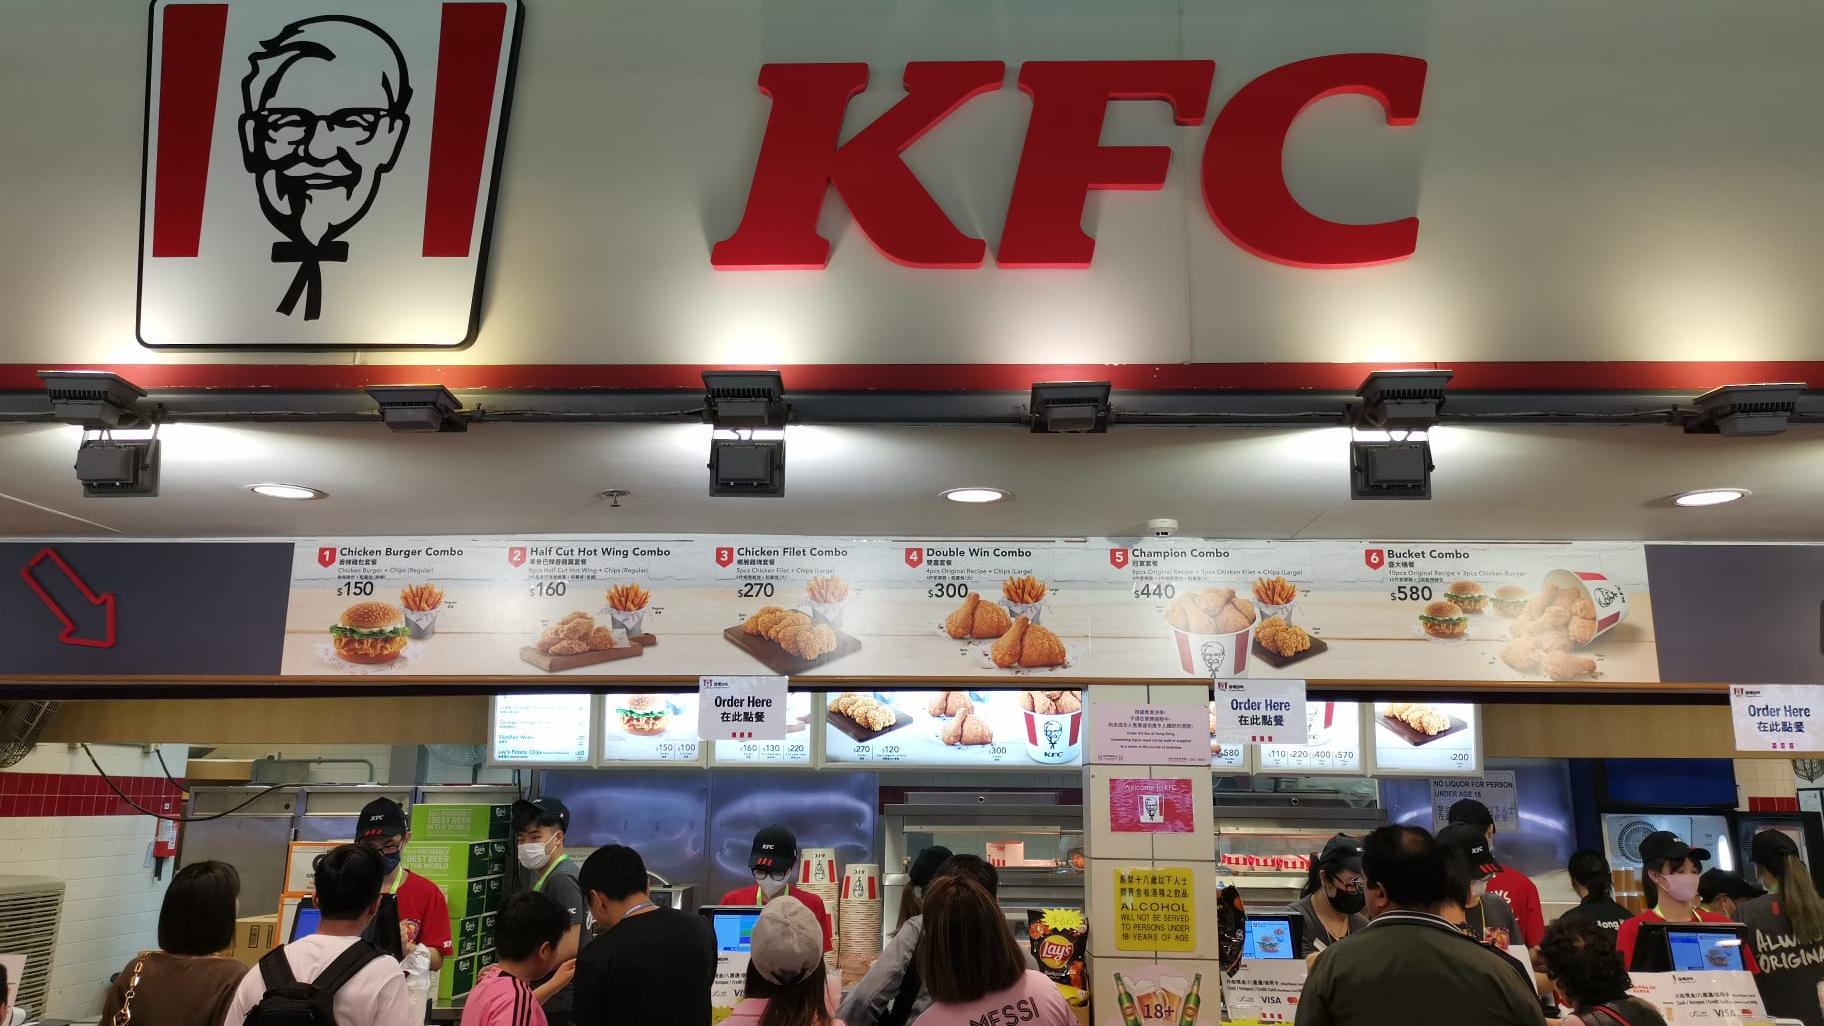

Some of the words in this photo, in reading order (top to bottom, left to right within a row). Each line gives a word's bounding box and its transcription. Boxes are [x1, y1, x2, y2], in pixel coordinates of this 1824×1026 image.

[711, 52, 1428, 271] KFC
[323, 550, 330, 561] 1
[340, 548, 381, 556] Chicken
[386, 548, 422, 558] Burger
[425, 548, 464, 556] Combo
[513, 550, 520, 561] 2
[530, 547, 553, 556] Half
[555, 547, 574, 556] Cut
[578, 547, 598, 556] Hot
[601, 547, 629, 558] Wing
[632, 547, 671, 556] Combo
[720, 550, 728, 561] 3
[737, 547, 779, 556] Chicken
[783, 547, 807, 556] Filet
[809, 547, 848, 556] Combo
[909, 551, 918, 561] 4
[926, 548, 965, 557] Double
[968, 548, 990, 557] Win
[993, 548, 1032, 557] Combo
[1116, 552, 1124, 562] 5
[1132, 548, 1187, 560] Champion
[1190, 548, 1230, 558] Combo
[1387, 550, 1426, 559] Bucket
[1429, 550, 1470, 559] Combo
[1370, 552, 1379, 564] 6
[337, 581, 374, 596] $150
[529, 582, 566, 597] $160
[737, 582, 775, 598] $270
[928, 583, 968, 598] $300
[1134, 584, 1176, 598] $440
[1390, 586, 1432, 600] $580
[714, 696, 745, 708] Order
[747, 696, 772, 708] Here
[1230, 698, 1262, 711] Order
[1264, 699, 1291, 711] Here
[1748, 704, 1781, 717] Order
[1784, 705, 1810, 717] Here
[720, 712, 765, 722] 在此點餐
[1238, 714, 1284, 726] 在此點餐
[1756, 721, 1805, 733] 在此點餐
[1445, 780, 1470, 788] LIQUOR
[1434, 790, 1458, 798] UNDER
[1120, 902, 1188, 912] ALCOHOL
[1136, 914, 1150, 922] NOT
[1152, 914, 1162, 922] BE
[1164, 914, 1190, 922] SERVED
[1134, 924, 1166, 932] PERSONS
[1168, 924, 1190, 932] UNDER
[1162, 934, 1172, 942] OF
[1174, 934, 1190, 942] AGE
[1262, 996, 1282, 1004] VISA
[969, 996, 1040, 1026] MESSI
[1143, 1004, 1174, 1018] 18+
